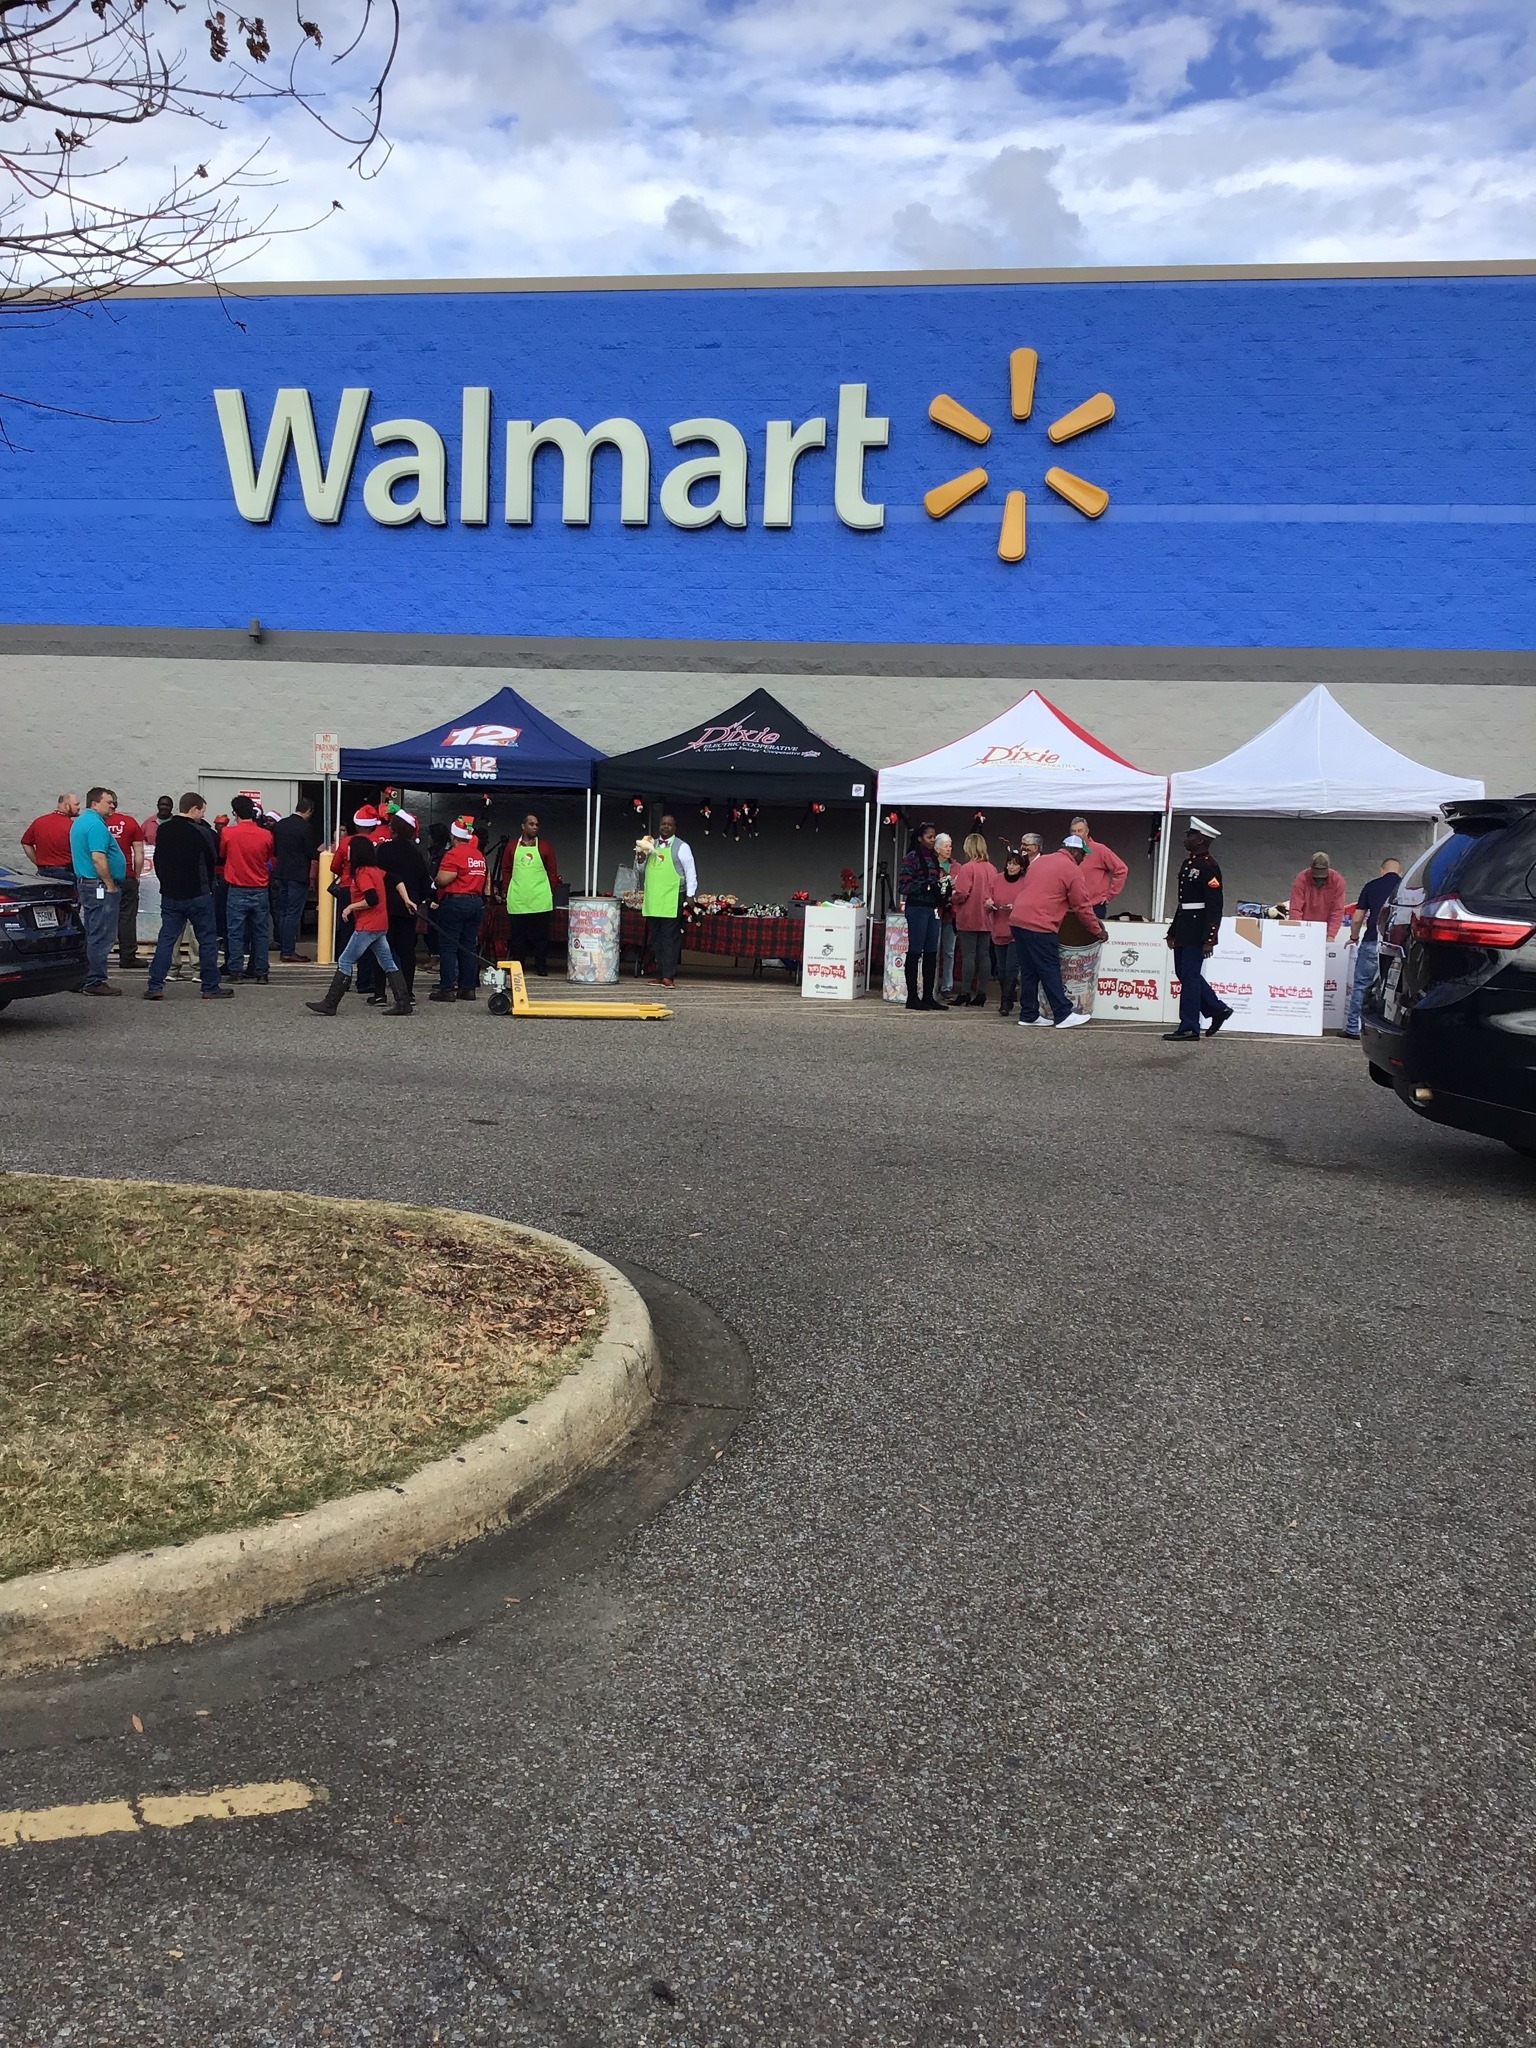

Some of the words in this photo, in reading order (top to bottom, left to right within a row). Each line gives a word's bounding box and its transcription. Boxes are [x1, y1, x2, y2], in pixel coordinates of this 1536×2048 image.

[212, 383, 890, 529] Walmart
[322, 734, 331, 742] NO
[450, 725, 518, 746] 12
[690, 726, 781, 749] Dixie
[315, 743, 339, 752] PARKING
[742, 742, 799, 751] COOPERATIVE
[320, 752, 333, 761] FIRE
[978, 746, 1061, 764] Dixie
[320, 762, 334, 771] LANE
[463, 771, 497, 780] News
[513, 973, 523, 993] Yale
[1098, 980, 1116, 990] TOYS
[1118, 984, 1133, 993] FOR
[1136, 985, 1155, 996] TOTS
